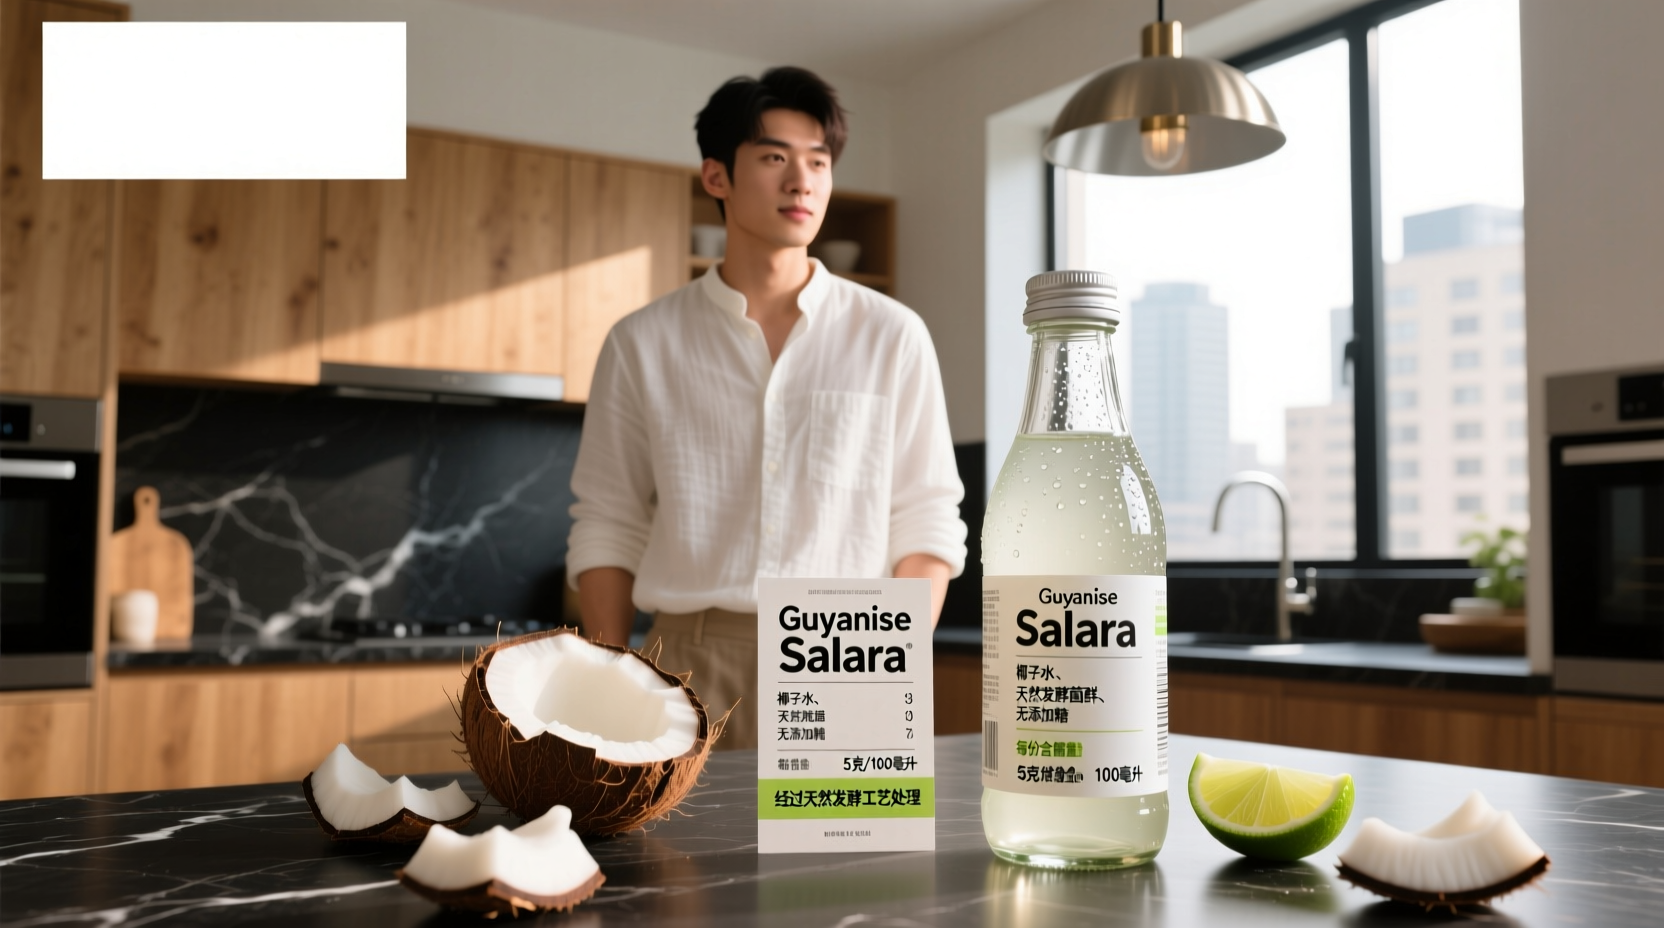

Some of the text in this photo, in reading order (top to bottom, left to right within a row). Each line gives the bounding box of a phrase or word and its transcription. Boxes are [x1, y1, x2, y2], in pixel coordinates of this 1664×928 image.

[1039, 587, 1118, 609] Guyanise
[779, 605, 912, 638] Guyanise
[1016, 609, 1136, 647] Salara
[1095, 765, 1143, 783] 100毫升
[774, 788, 921, 808] 经过天然发酵工艺处理
